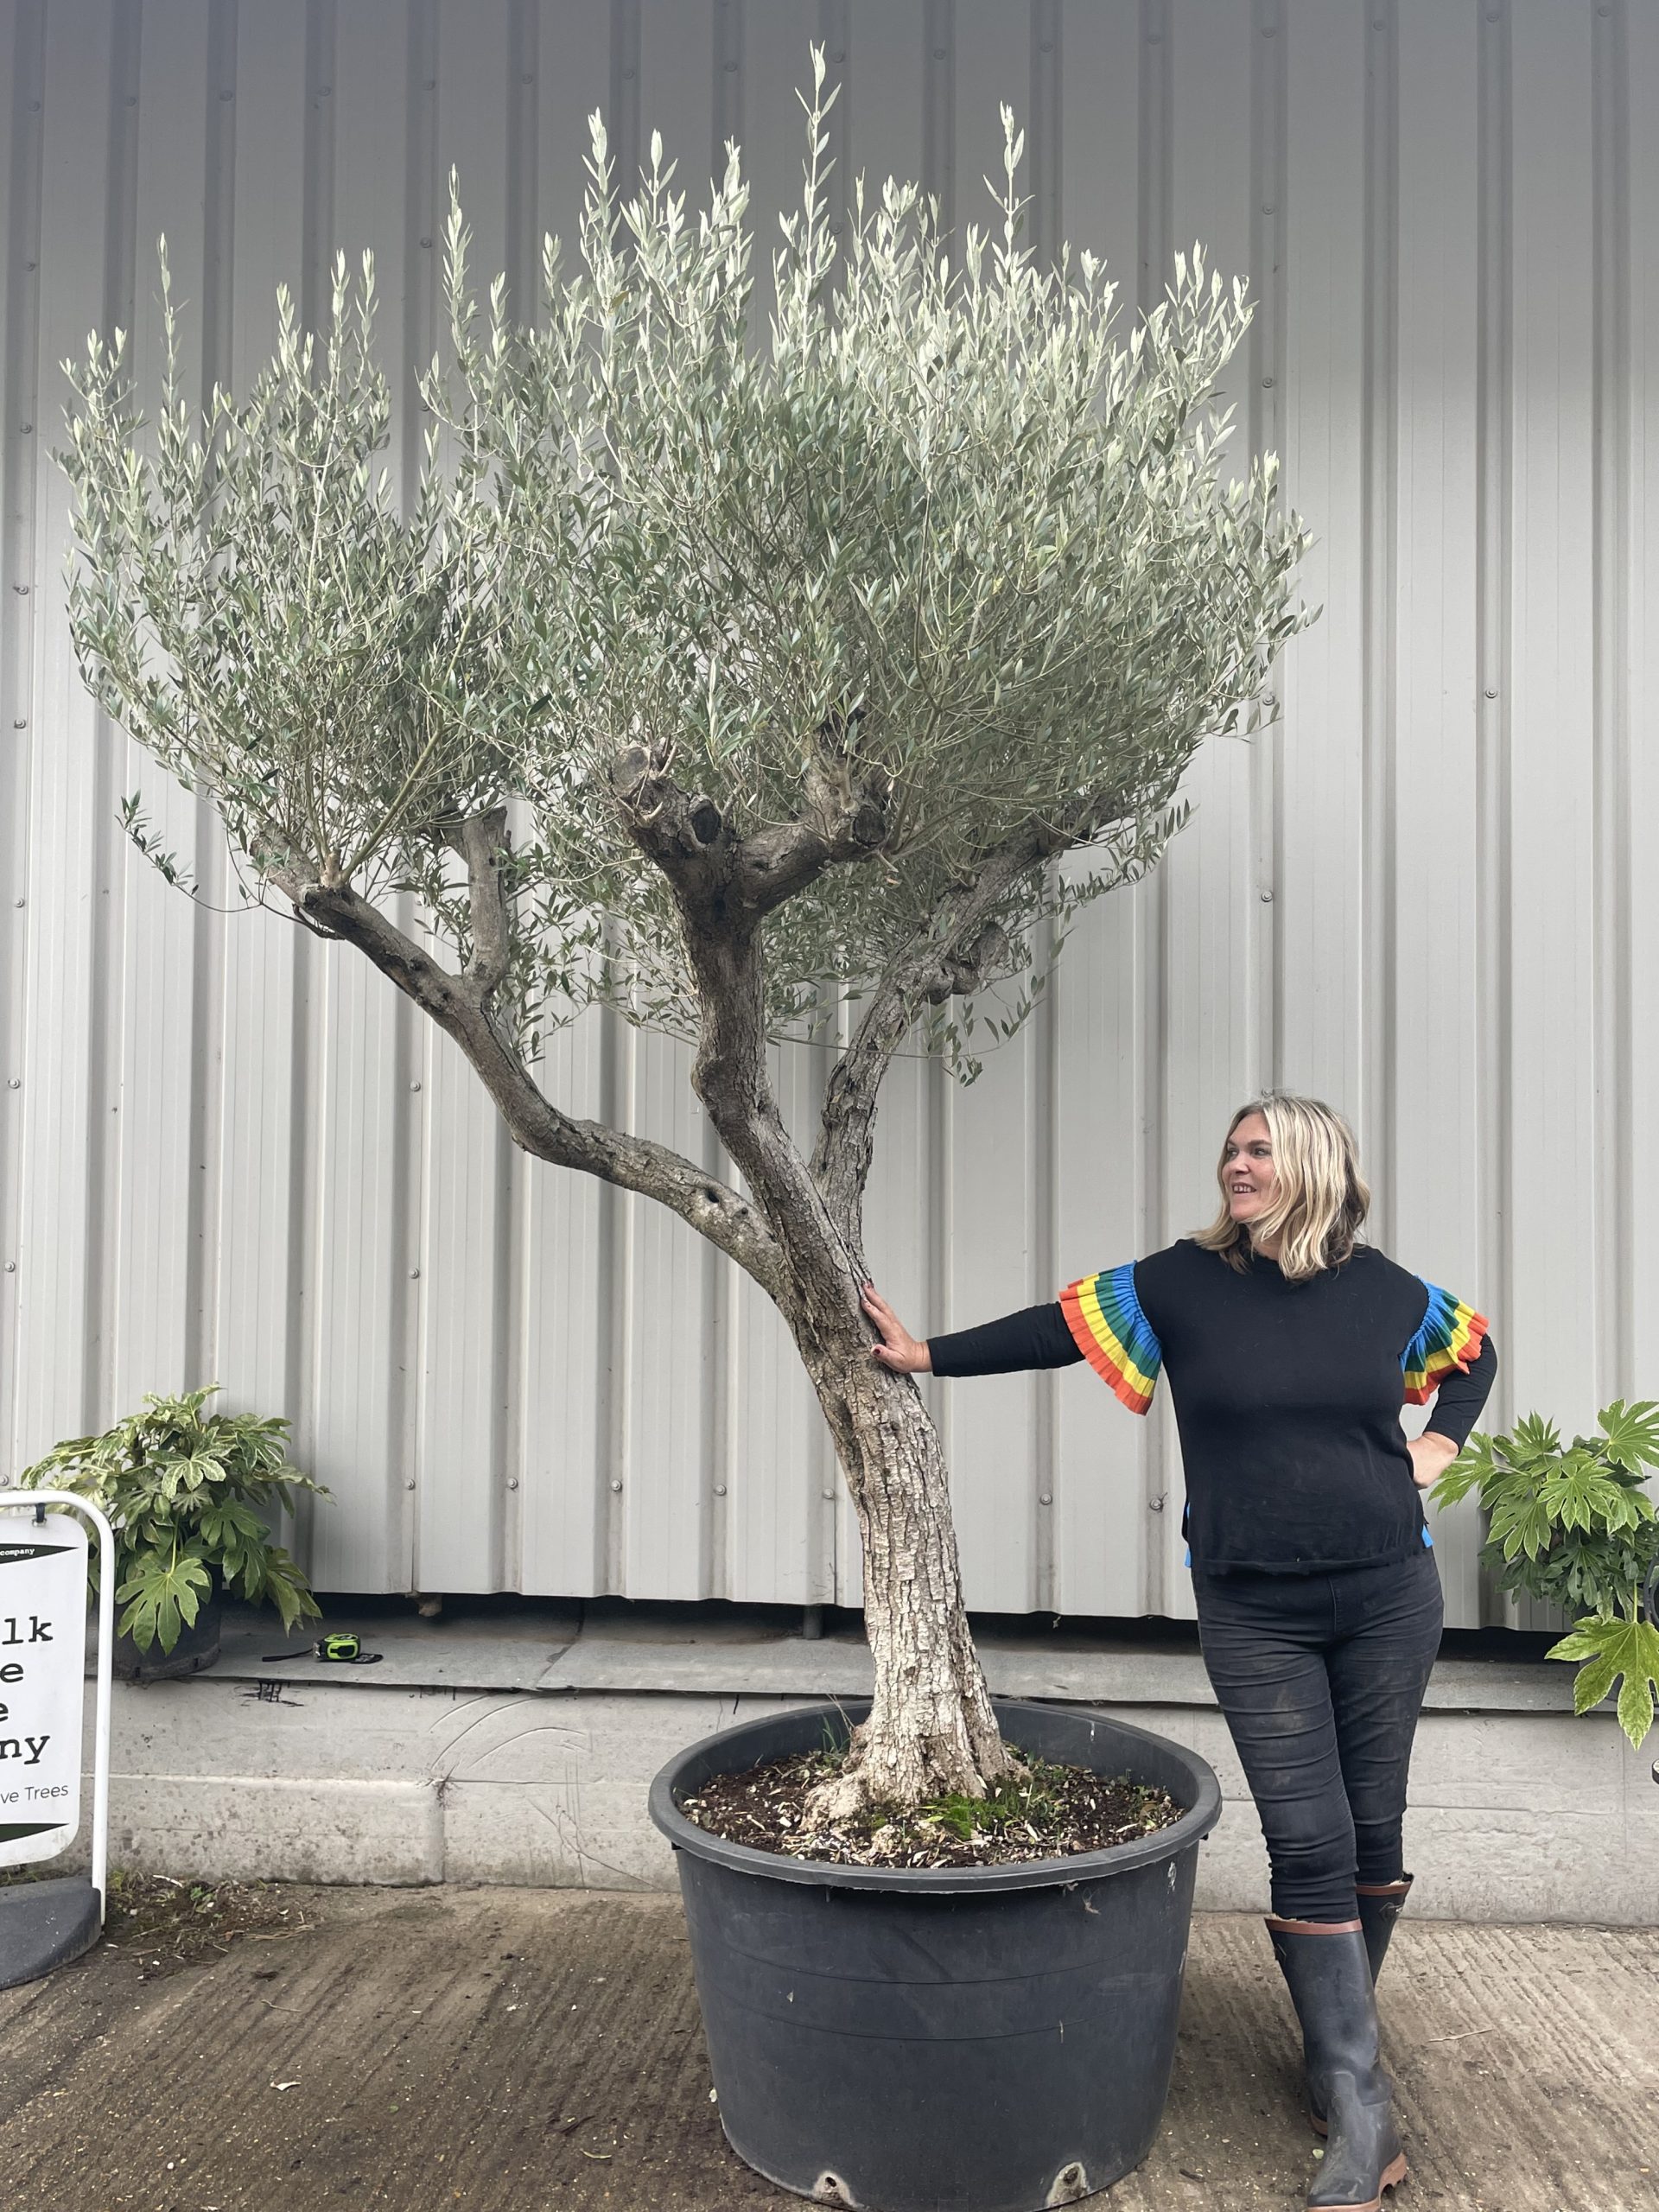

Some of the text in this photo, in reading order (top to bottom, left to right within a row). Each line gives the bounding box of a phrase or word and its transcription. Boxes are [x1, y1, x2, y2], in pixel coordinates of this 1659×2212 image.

[0, 1735, 51, 1764] ny
[0, 1785, 68, 1804] ve Trees
